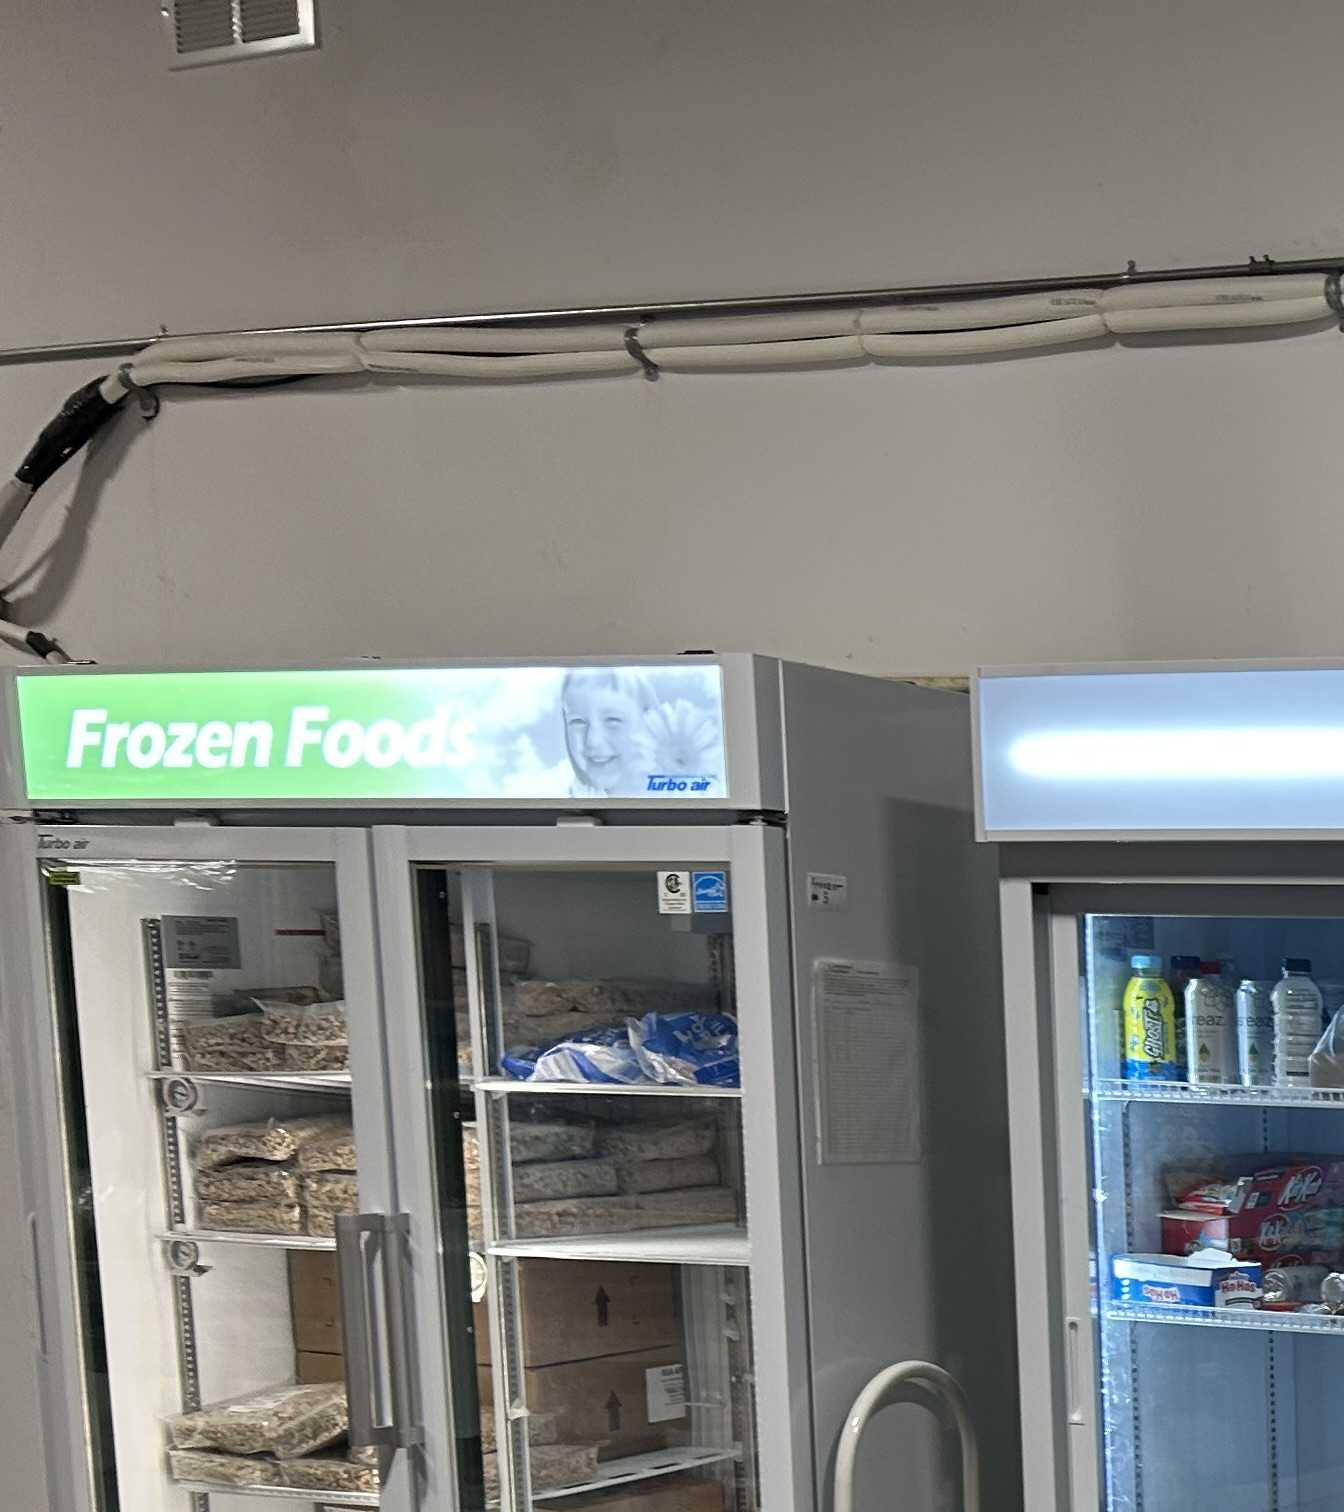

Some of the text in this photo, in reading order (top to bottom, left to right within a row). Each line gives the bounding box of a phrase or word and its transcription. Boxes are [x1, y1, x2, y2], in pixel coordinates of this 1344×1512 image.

[66, 705, 478, 769] Frozen Foods
[647, 774, 711, 791] Turbo air
